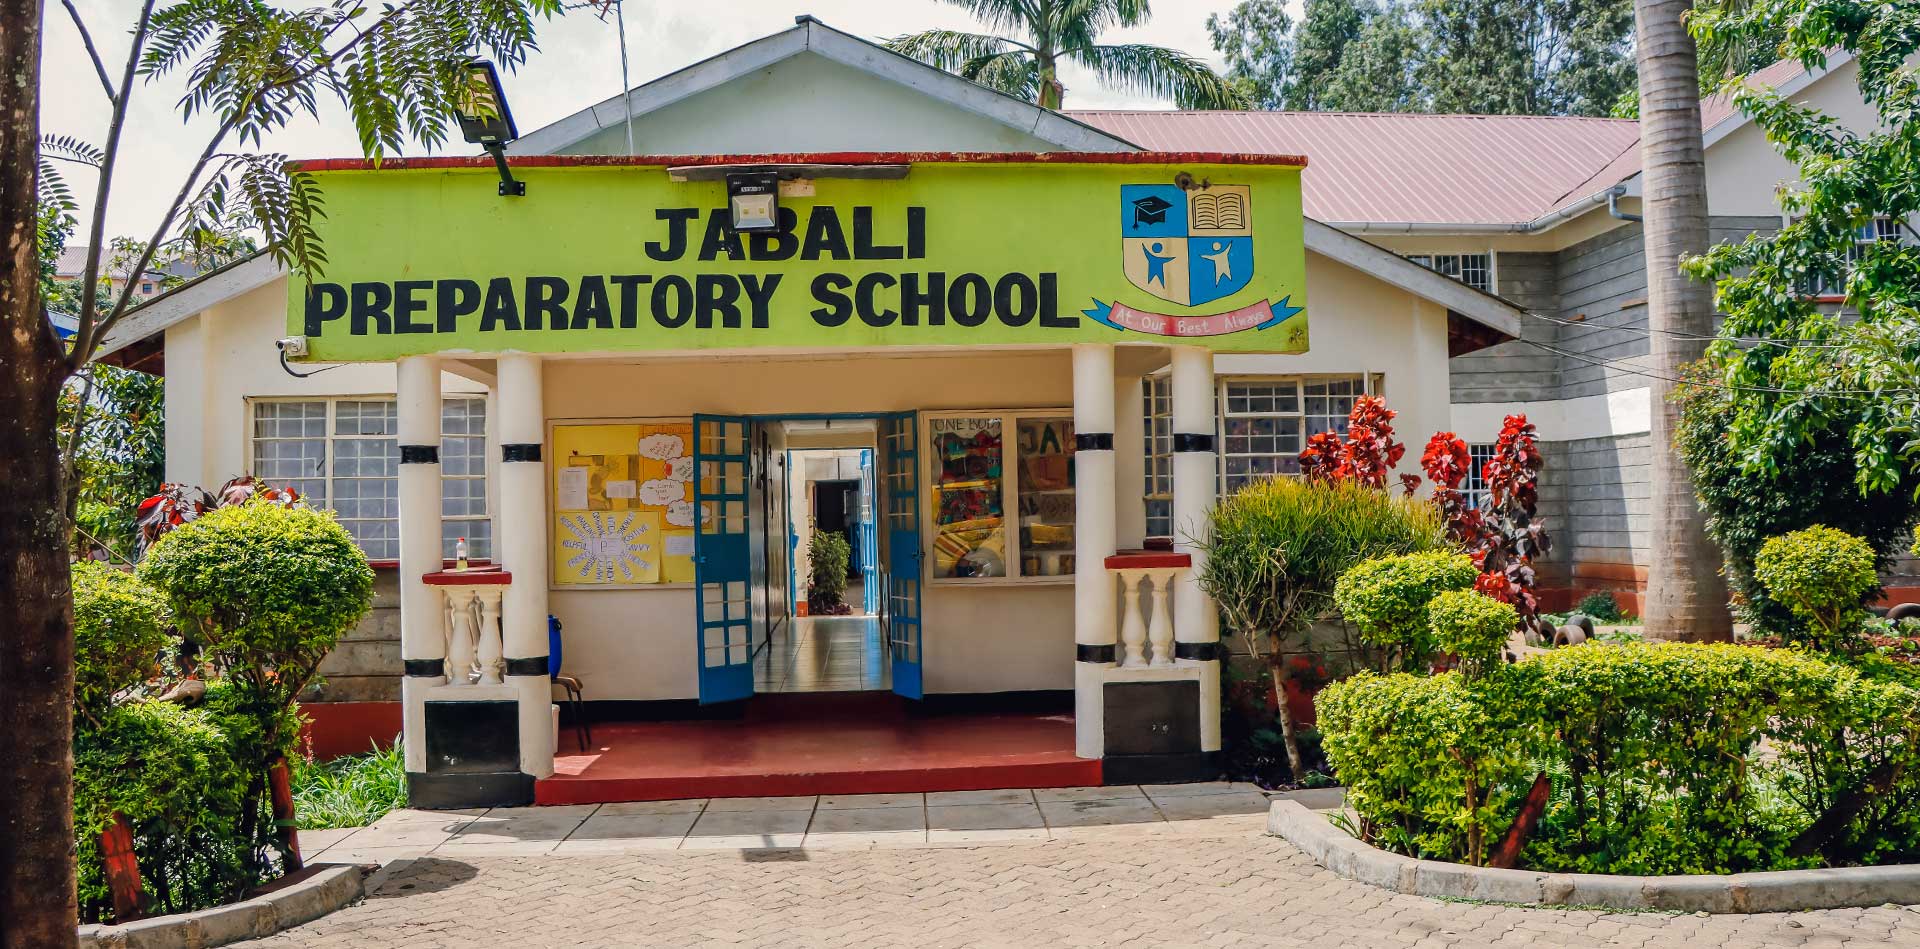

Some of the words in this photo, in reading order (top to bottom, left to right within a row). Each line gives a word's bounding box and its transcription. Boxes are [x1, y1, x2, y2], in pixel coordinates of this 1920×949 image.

[645, 206, 926, 262] JABALI
[304, 274, 784, 338] PREPARATORY
[810, 271, 1080, 329] SCHOOL
[1115, 308, 1133, 325] At
[1141, 315, 1166, 331] Our
[1177, 319, 1210, 335] Best
[1223, 311, 1266, 330] Always
[935, 419, 965, 431] ONE
